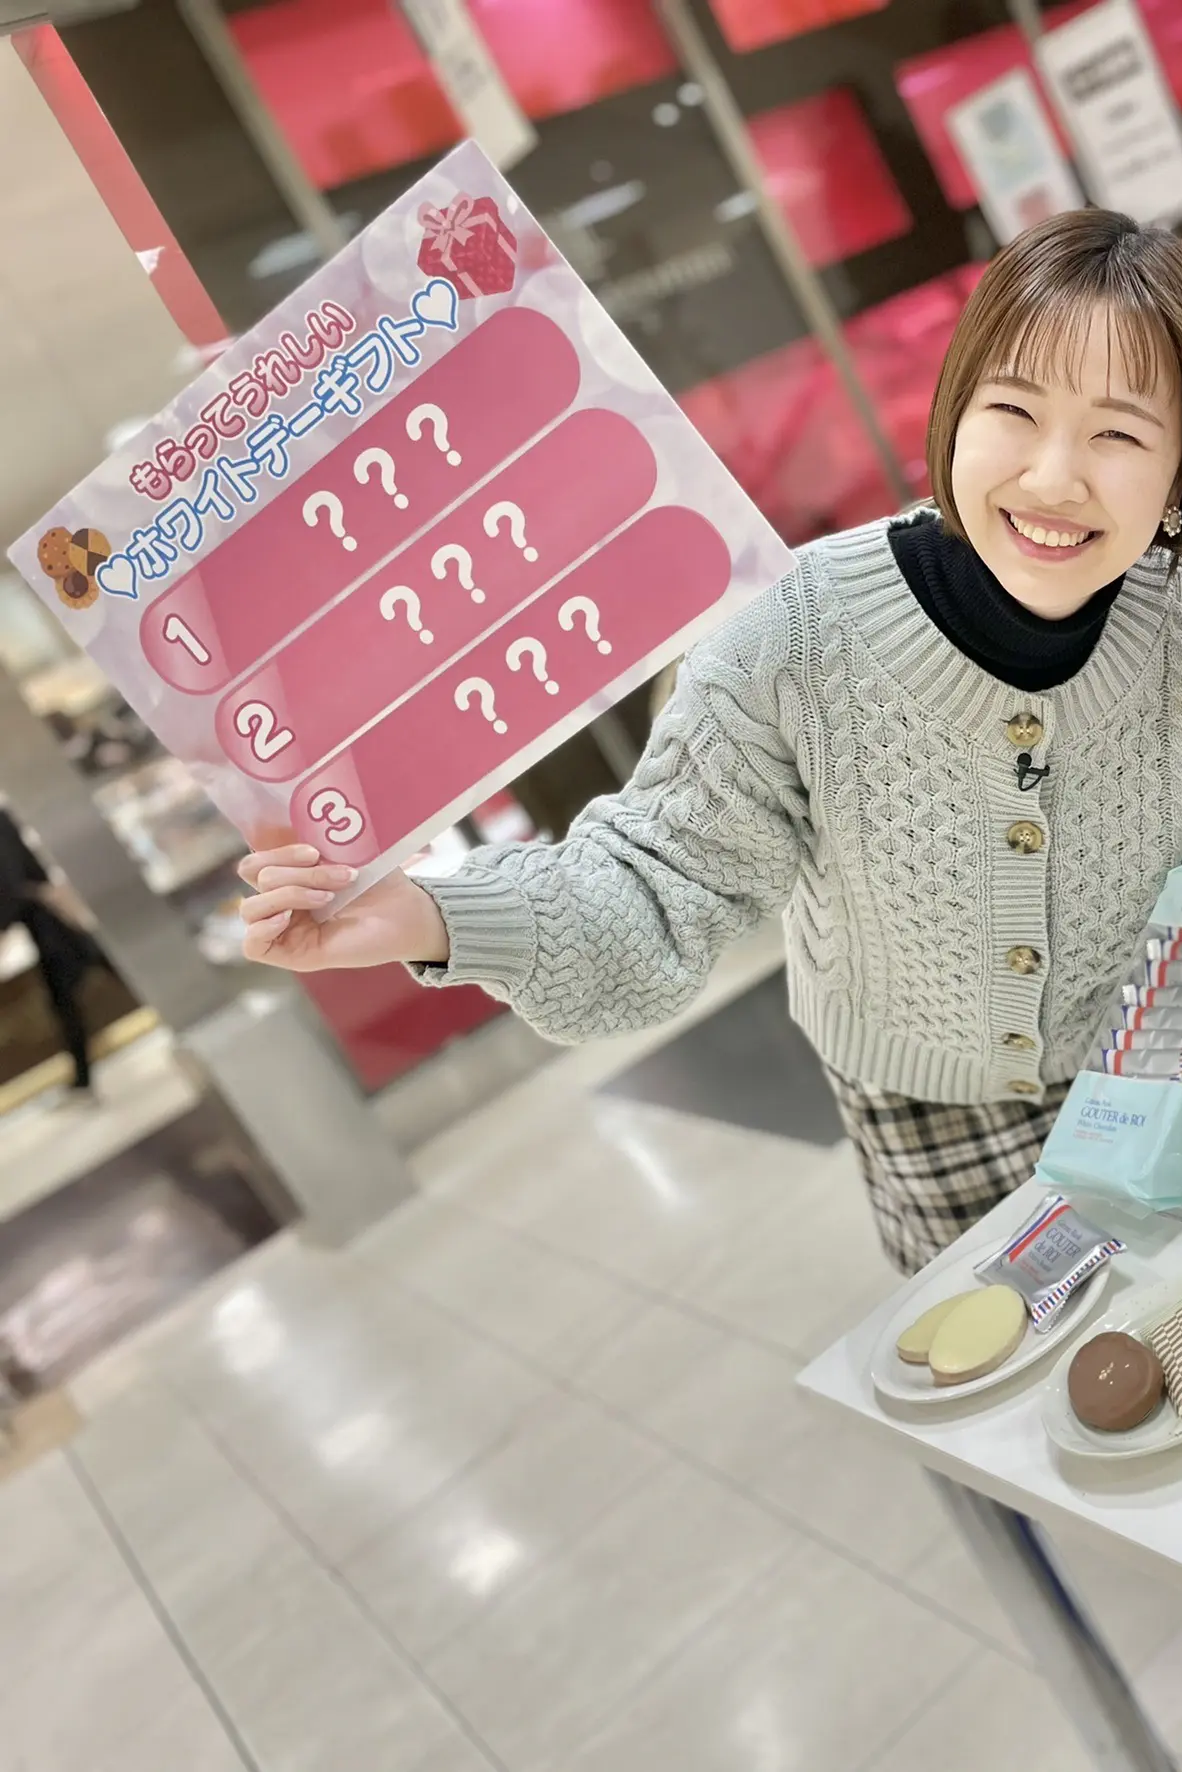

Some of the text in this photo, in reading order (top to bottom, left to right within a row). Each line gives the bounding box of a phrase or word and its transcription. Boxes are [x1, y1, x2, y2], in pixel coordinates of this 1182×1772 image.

[129, 302, 354, 500] もらってうれしい
[163, 614, 212, 666] 1
[234, 699, 295, 763] 2
[307, 787, 366, 846] 3
[1080, 1105, 1148, 1128] GOUTER de ROI
[1034, 1239, 1047, 1253] de
[1042, 1246, 1062, 1264] ROI
[1046, 1227, 1082, 1259] GOUTER
